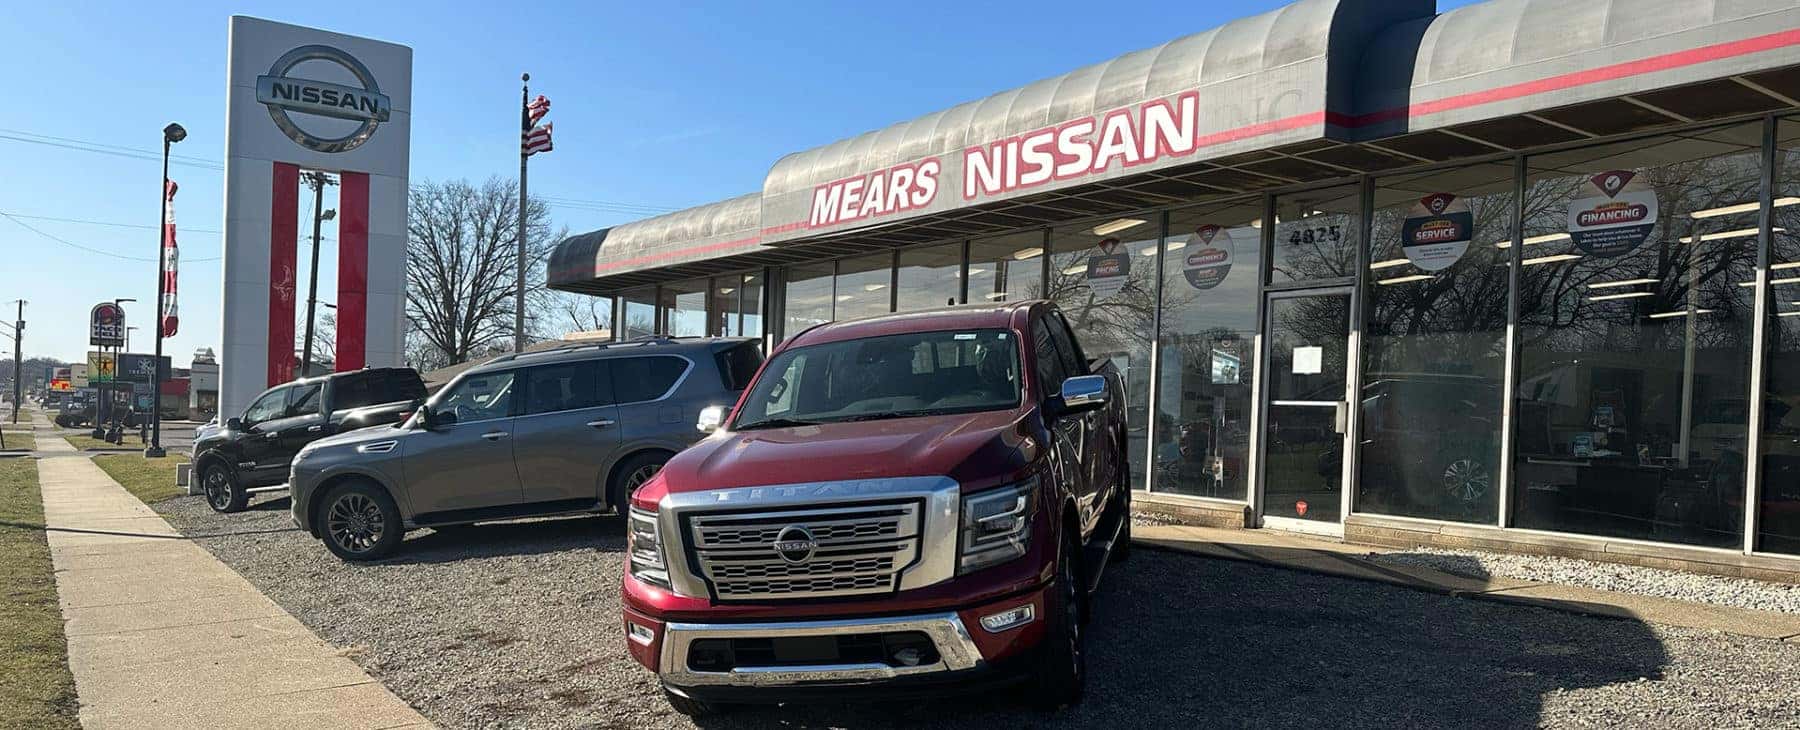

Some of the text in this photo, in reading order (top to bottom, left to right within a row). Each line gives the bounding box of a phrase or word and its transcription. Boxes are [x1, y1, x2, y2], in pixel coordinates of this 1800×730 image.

[271, 82, 379, 114] NISSAN
[808, 158, 940, 227] MEARS
[965, 95, 1196, 198] NISSAN
[1581, 207, 1640, 223] FINANCING
[1289, 225, 1341, 246] 4825
[1415, 227, 1456, 241] SERVICE
[774, 540, 818, 550] NISSAN
